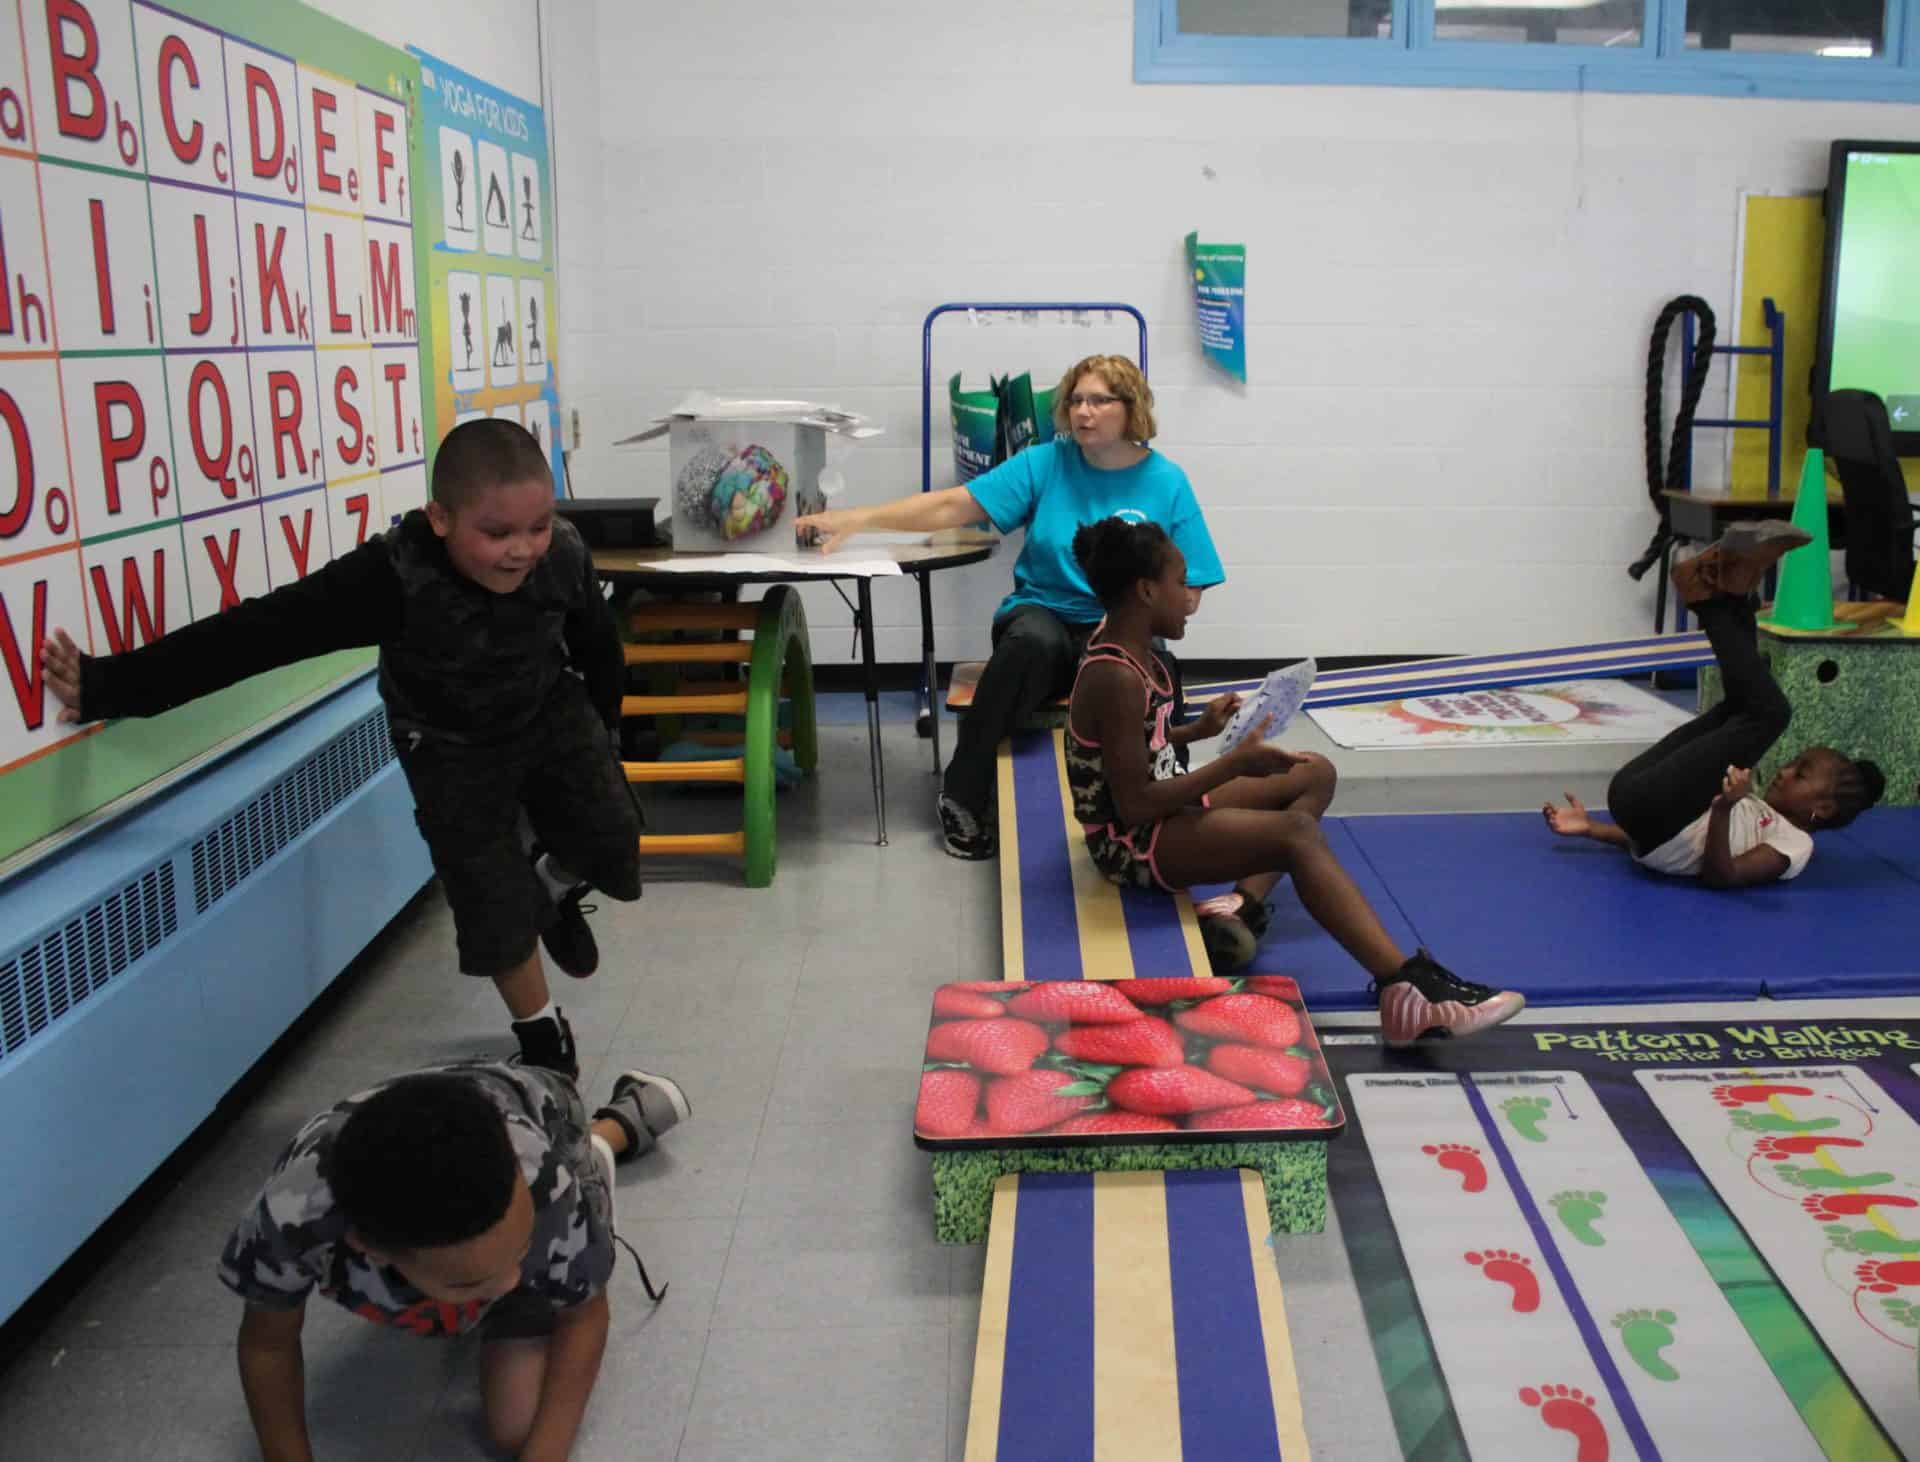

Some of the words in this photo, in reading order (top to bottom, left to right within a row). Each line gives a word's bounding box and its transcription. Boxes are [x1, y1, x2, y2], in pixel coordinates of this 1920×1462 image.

[45, 0, 108, 142] B
[114, 100, 139, 167] b
[157, 34, 204, 165] C
[212, 142, 229, 184] c
[244, 63, 285, 180] D
[284, 143, 298, 195] d
[438, 76, 477, 121] YOGA
[311, 87, 342, 194] E
[346, 167, 360, 203] e
[374, 109, 394, 204] F
[17, 273, 47, 344] h
[143, 283, 154, 344] i
[188, 213, 214, 335] J
[229, 276, 239, 346] j
[254, 222, 296, 335] K
[295, 289, 309, 341] k
[324, 232, 353, 334] L
[368, 239, 403, 334] M
[401, 307, 416, 339] m
[93, 380, 146, 515] P
[149, 455, 170, 517] p
[187, 360, 237, 499] Q
[237, 444, 256, 497] q
[267, 370, 308, 479] R
[311, 448, 320, 480] r
[334, 364, 363, 465] S
[366, 434, 376, 467] s
[384, 363, 406, 453] T
[412, 417, 420, 455] t
[45, 487, 69, 536] o
[0, 578, 48, 731] V
[89, 548, 166, 656] W
[1532, 1029, 1721, 1051] Pattern
[1724, 1025, 1920, 1050] Walking
[1595, 1048, 1721, 1063] Transfer
[1731, 1047, 1766, 1062] to
[1769, 1045, 1883, 1061] Bridges
